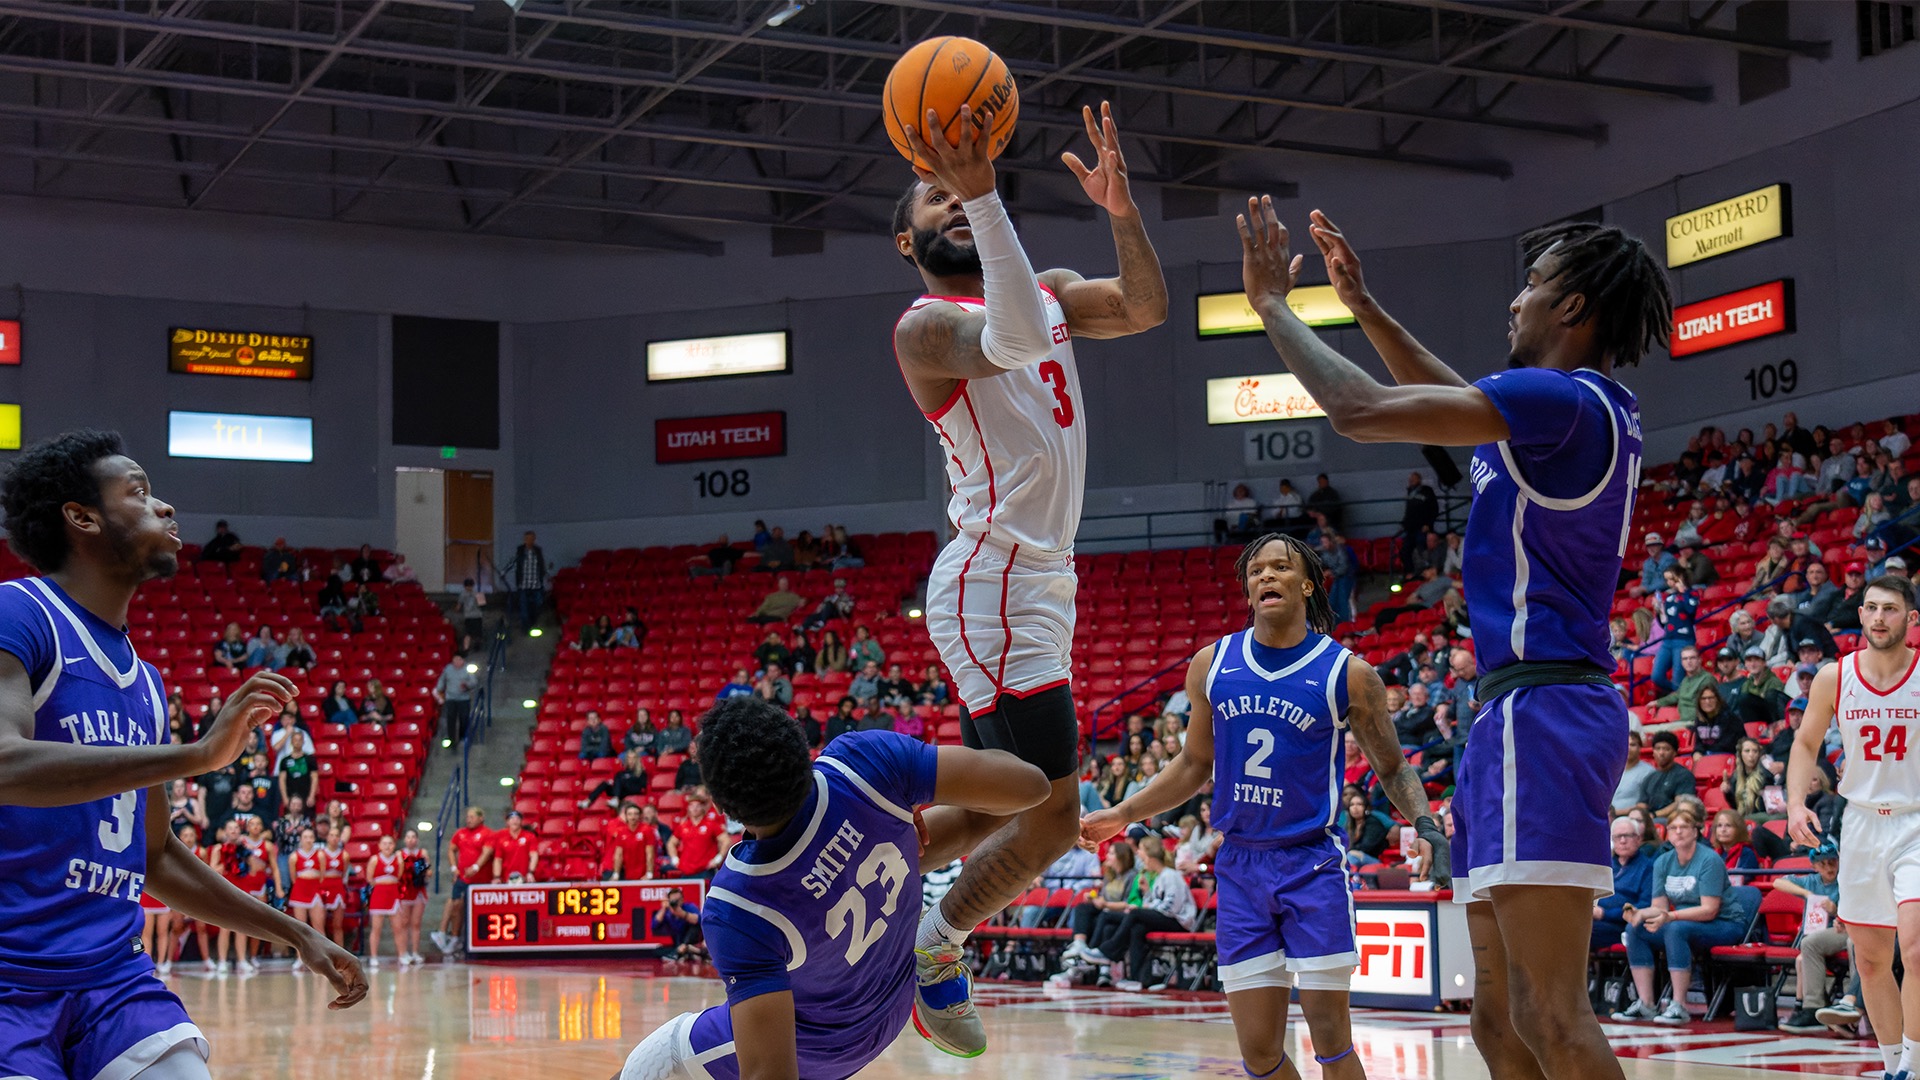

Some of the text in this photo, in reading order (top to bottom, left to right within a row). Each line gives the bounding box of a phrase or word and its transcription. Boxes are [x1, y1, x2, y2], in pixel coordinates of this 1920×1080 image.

[1670, 194, 1768, 239] COURTYARD
[1692, 227, 1743, 257] Marriott
[1678, 299, 1774, 341] UTAH TECH
[195, 330, 310, 348] DIXIE DIRECT
[1038, 360, 1075, 429] 3
[1744, 359, 1798, 400] 109
[213, 418, 263, 448] tru
[667, 426, 770, 448] UTAH TECH
[1250, 430, 1315, 461] 108
[693, 469, 750, 498] 108
[59, 709, 150, 746] TARLET
[1217, 694, 1316, 732] TARLETON
[1845, 708, 1920, 720] UTAH TECH
[1244, 727, 1275, 779] 2
[1859, 725, 1907, 762] 24
[1233, 782, 1284, 808] STATE
[98, 789, 137, 853] 3
[801, 818, 865, 899] SMITH
[65, 858, 145, 903] STATE
[474, 890, 545, 905] UTAH TECH
[557, 888, 620, 916] 19:32
[825, 841, 910, 966] 23
[488, 914, 517, 940] 32
[556, 925, 590, 937] PERIOD
